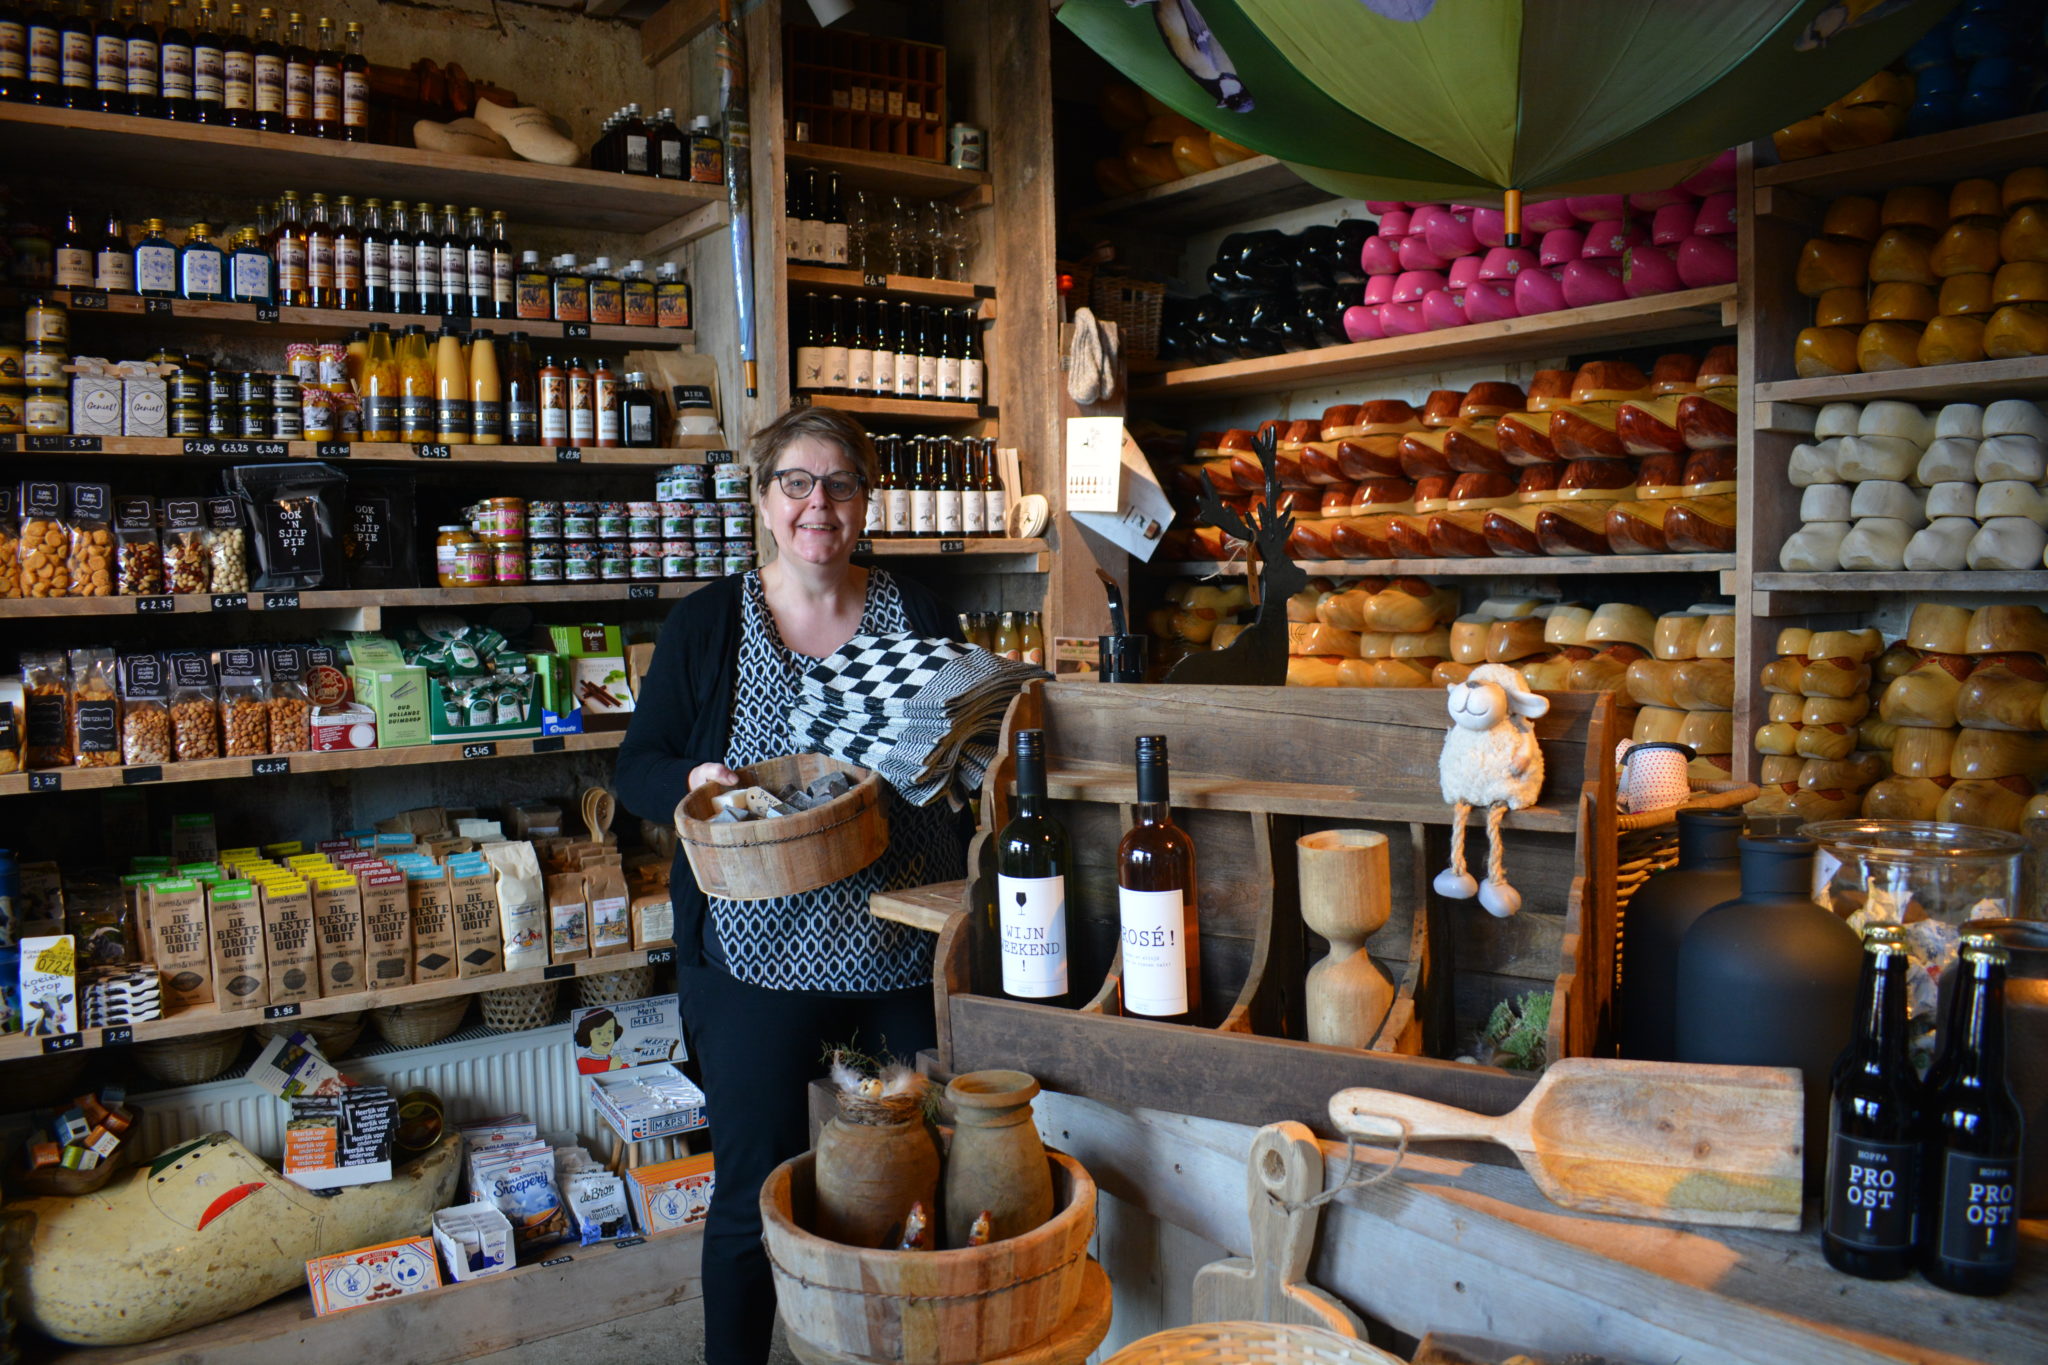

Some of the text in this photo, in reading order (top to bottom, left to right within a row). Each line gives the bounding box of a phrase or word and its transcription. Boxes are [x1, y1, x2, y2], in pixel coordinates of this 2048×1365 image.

[422, 445, 448, 457] 8.95
[280, 511, 302, 520] OOK
[355, 505, 375, 514] OOK
[279, 529, 307, 538] SJIP
[353, 524, 380, 532] SJIP
[283, 539, 305, 547] PIE
[357, 533, 378, 542] PIE
[422, 896, 437, 906] DE
[467, 892, 483, 902] DE
[329, 904, 346, 914] DE
[379, 903, 396, 913] DE
[411, 905, 449, 917] BESTE
[456, 900, 495, 913] BESTE
[173, 914, 189, 924] DE
[281, 911, 298, 921] DE
[319, 912, 360, 925] BESTE
[368, 912, 408, 924] BESTE
[415, 914, 447, 926] DROP
[460, 910, 493, 922] DROP
[160, 922, 204, 935] BESTE
[229, 917, 246, 928] DE
[269, 919, 311, 932] BESTE
[323, 923, 356, 934] DROP
[372, 921, 405, 933] DROP
[463, 919, 491, 930] OOIT
[216, 925, 260, 940] BESTE
[274, 929, 308, 941] DROP
[417, 923, 445, 935] OOIT
[1006, 925, 1044, 939] WIJN
[165, 932, 201, 944] DROP
[221, 936, 257, 948] DROP
[325, 932, 355, 944] OOIT
[374, 931, 403, 942] OOIT
[167, 942, 199, 954] OOIT
[276, 938, 307, 951] OOIT
[224, 946, 255, 958] OOIT
[1848, 1164, 1896, 1188] PRO
[1847, 1186, 1894, 1209] OST
[1968, 1183, 2013, 1203] PRO
[1865, 1210, 1872, 1229] !
[1966, 1204, 2012, 1225] OST
[1986, 1227, 1993, 1246] !
